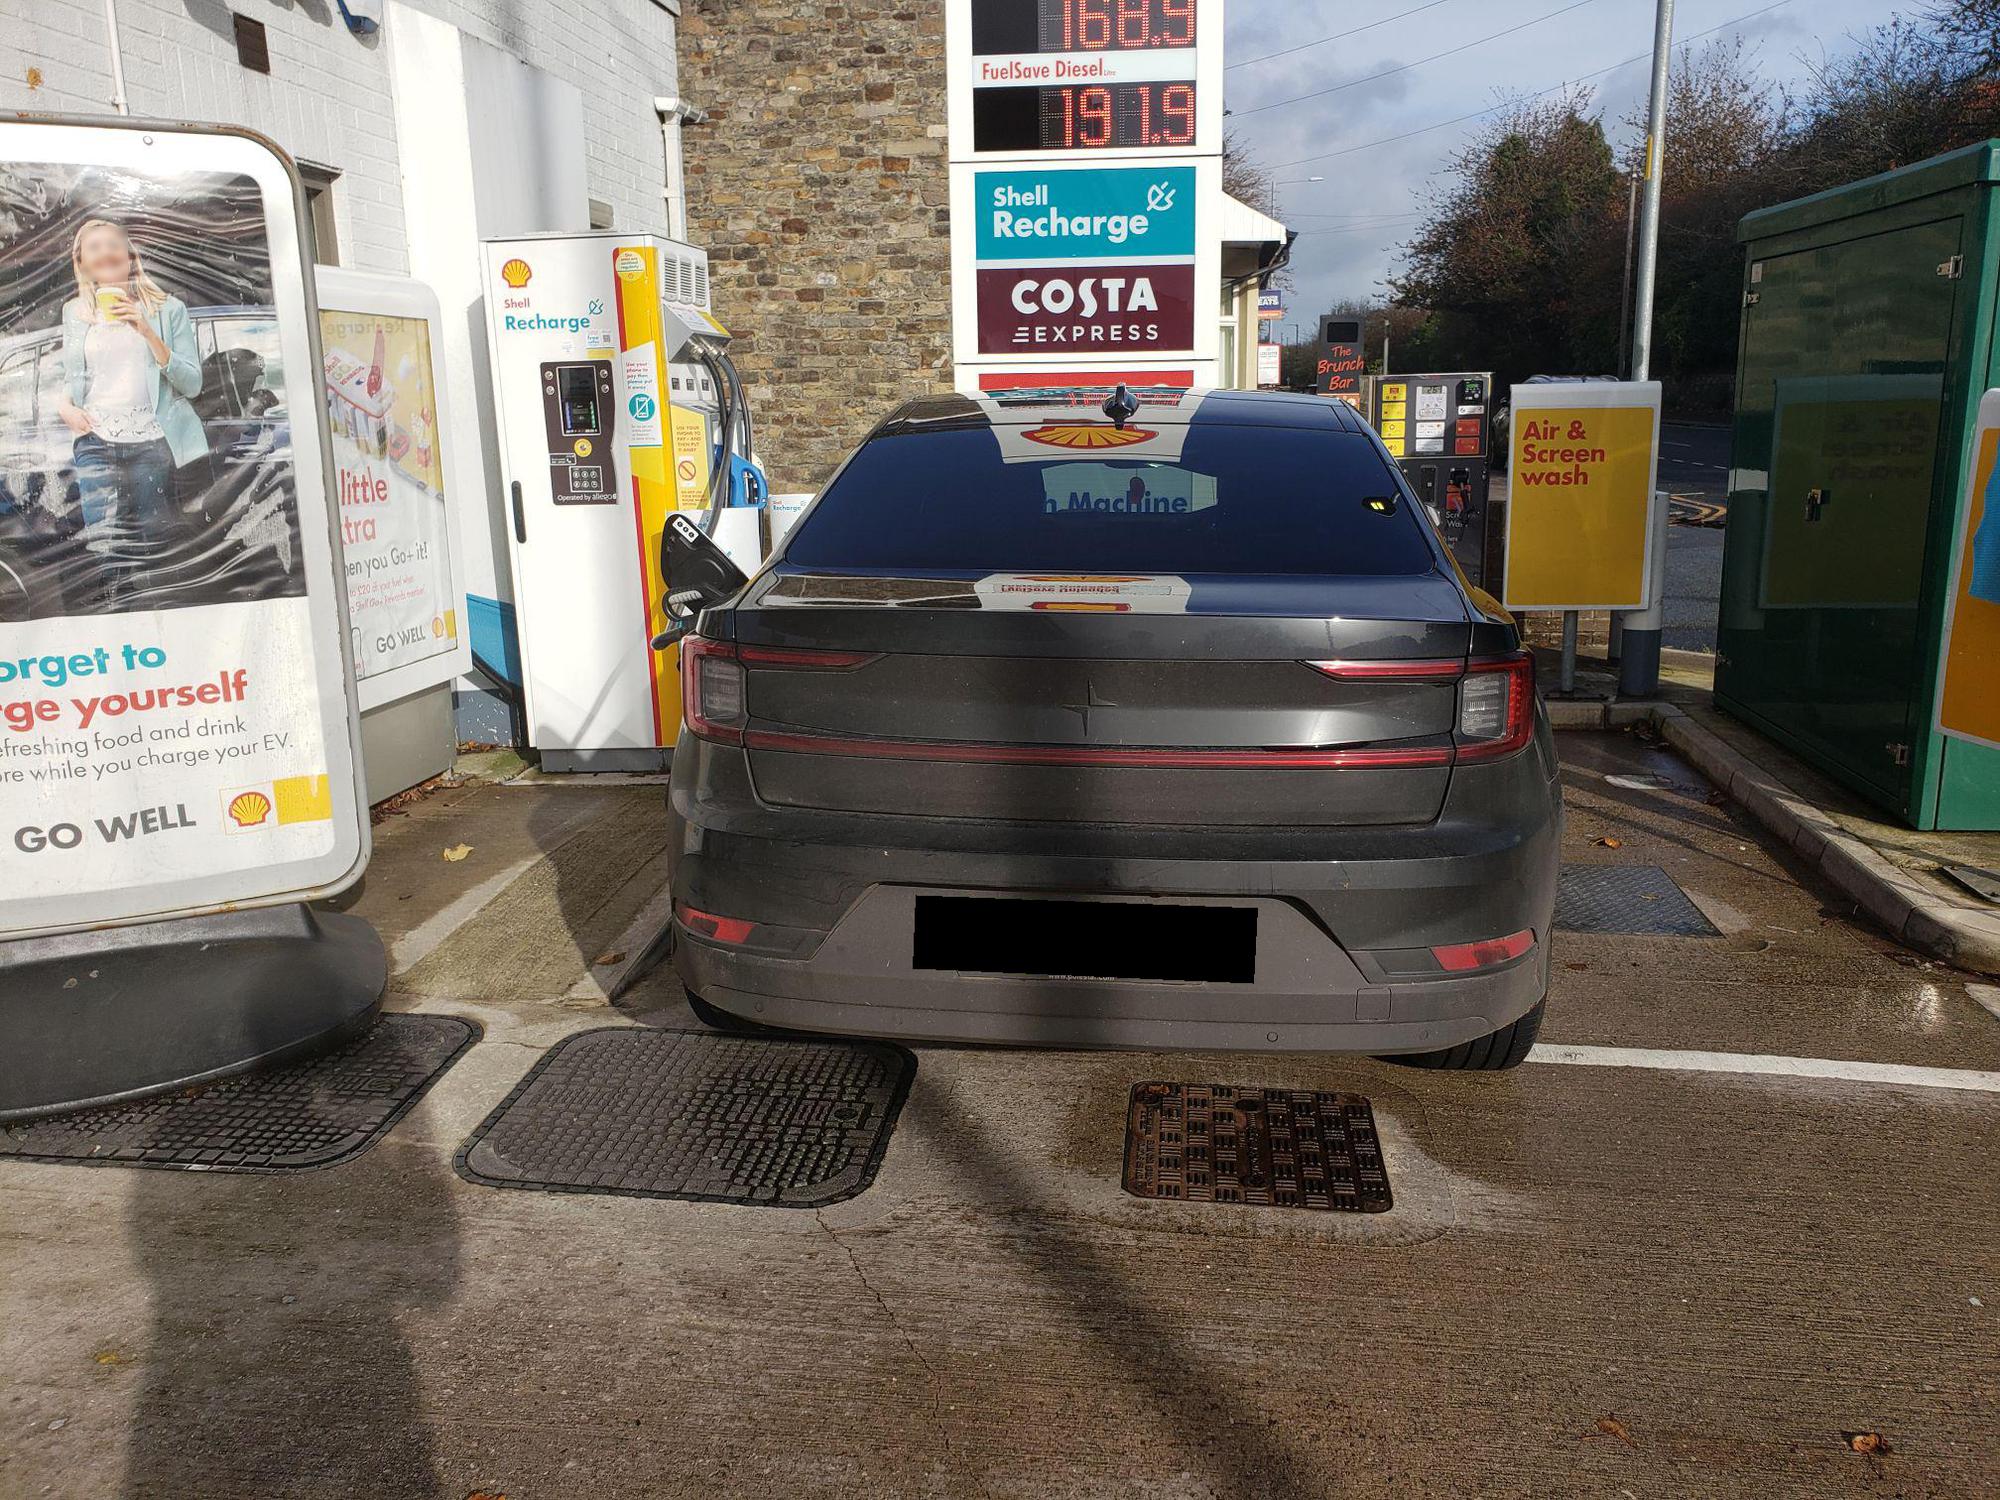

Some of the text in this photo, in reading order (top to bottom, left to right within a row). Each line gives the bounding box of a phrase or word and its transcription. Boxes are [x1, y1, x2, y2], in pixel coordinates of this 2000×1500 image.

[1064, 0, 1194, 49] 168.9
[982, 61, 1050, 81] FuelSave
[1055, 58, 1103, 78] Diesel
[1062, 85, 1194, 147] 191.9
[993, 184, 1048, 207] Shell
[993, 207, 1149, 243] Recharge
[504, 297, 530, 309] Shell
[1011, 278, 1158, 318] COSTA
[505, 313, 591, 333] Recharge
[1034, 324, 1159, 342] EXPRESS
[1331, 345, 1352, 358] The
[1317, 354, 1364, 375] Brunch
[1329, 375, 1354, 390] Bar
[1522, 420, 1586, 441] Air &
[1522, 443, 1606, 464] Screen
[341, 467, 388, 505] little
[1520, 464, 1589, 486] wash
[592, 493, 612, 501] allego
[773, 504, 802, 512] Recharge
[1068, 490, 1188, 513] Machine
[364, 556, 388, 578] you
[390, 547, 415, 565] Go+
[415, 541, 428, 560] it!
[357, 583, 371, 596] £20
[376, 623, 427, 653] GO WELL
[0, 644, 167, 687] orget to
[0, 668, 248, 732] ge yourself
[94, 725, 143, 751] food
[149, 719, 190, 742] and
[197, 715, 248, 737] drink
[0, 732, 294, 783] re while you charge your EV.
[14, 803, 197, 853] GO WELL
